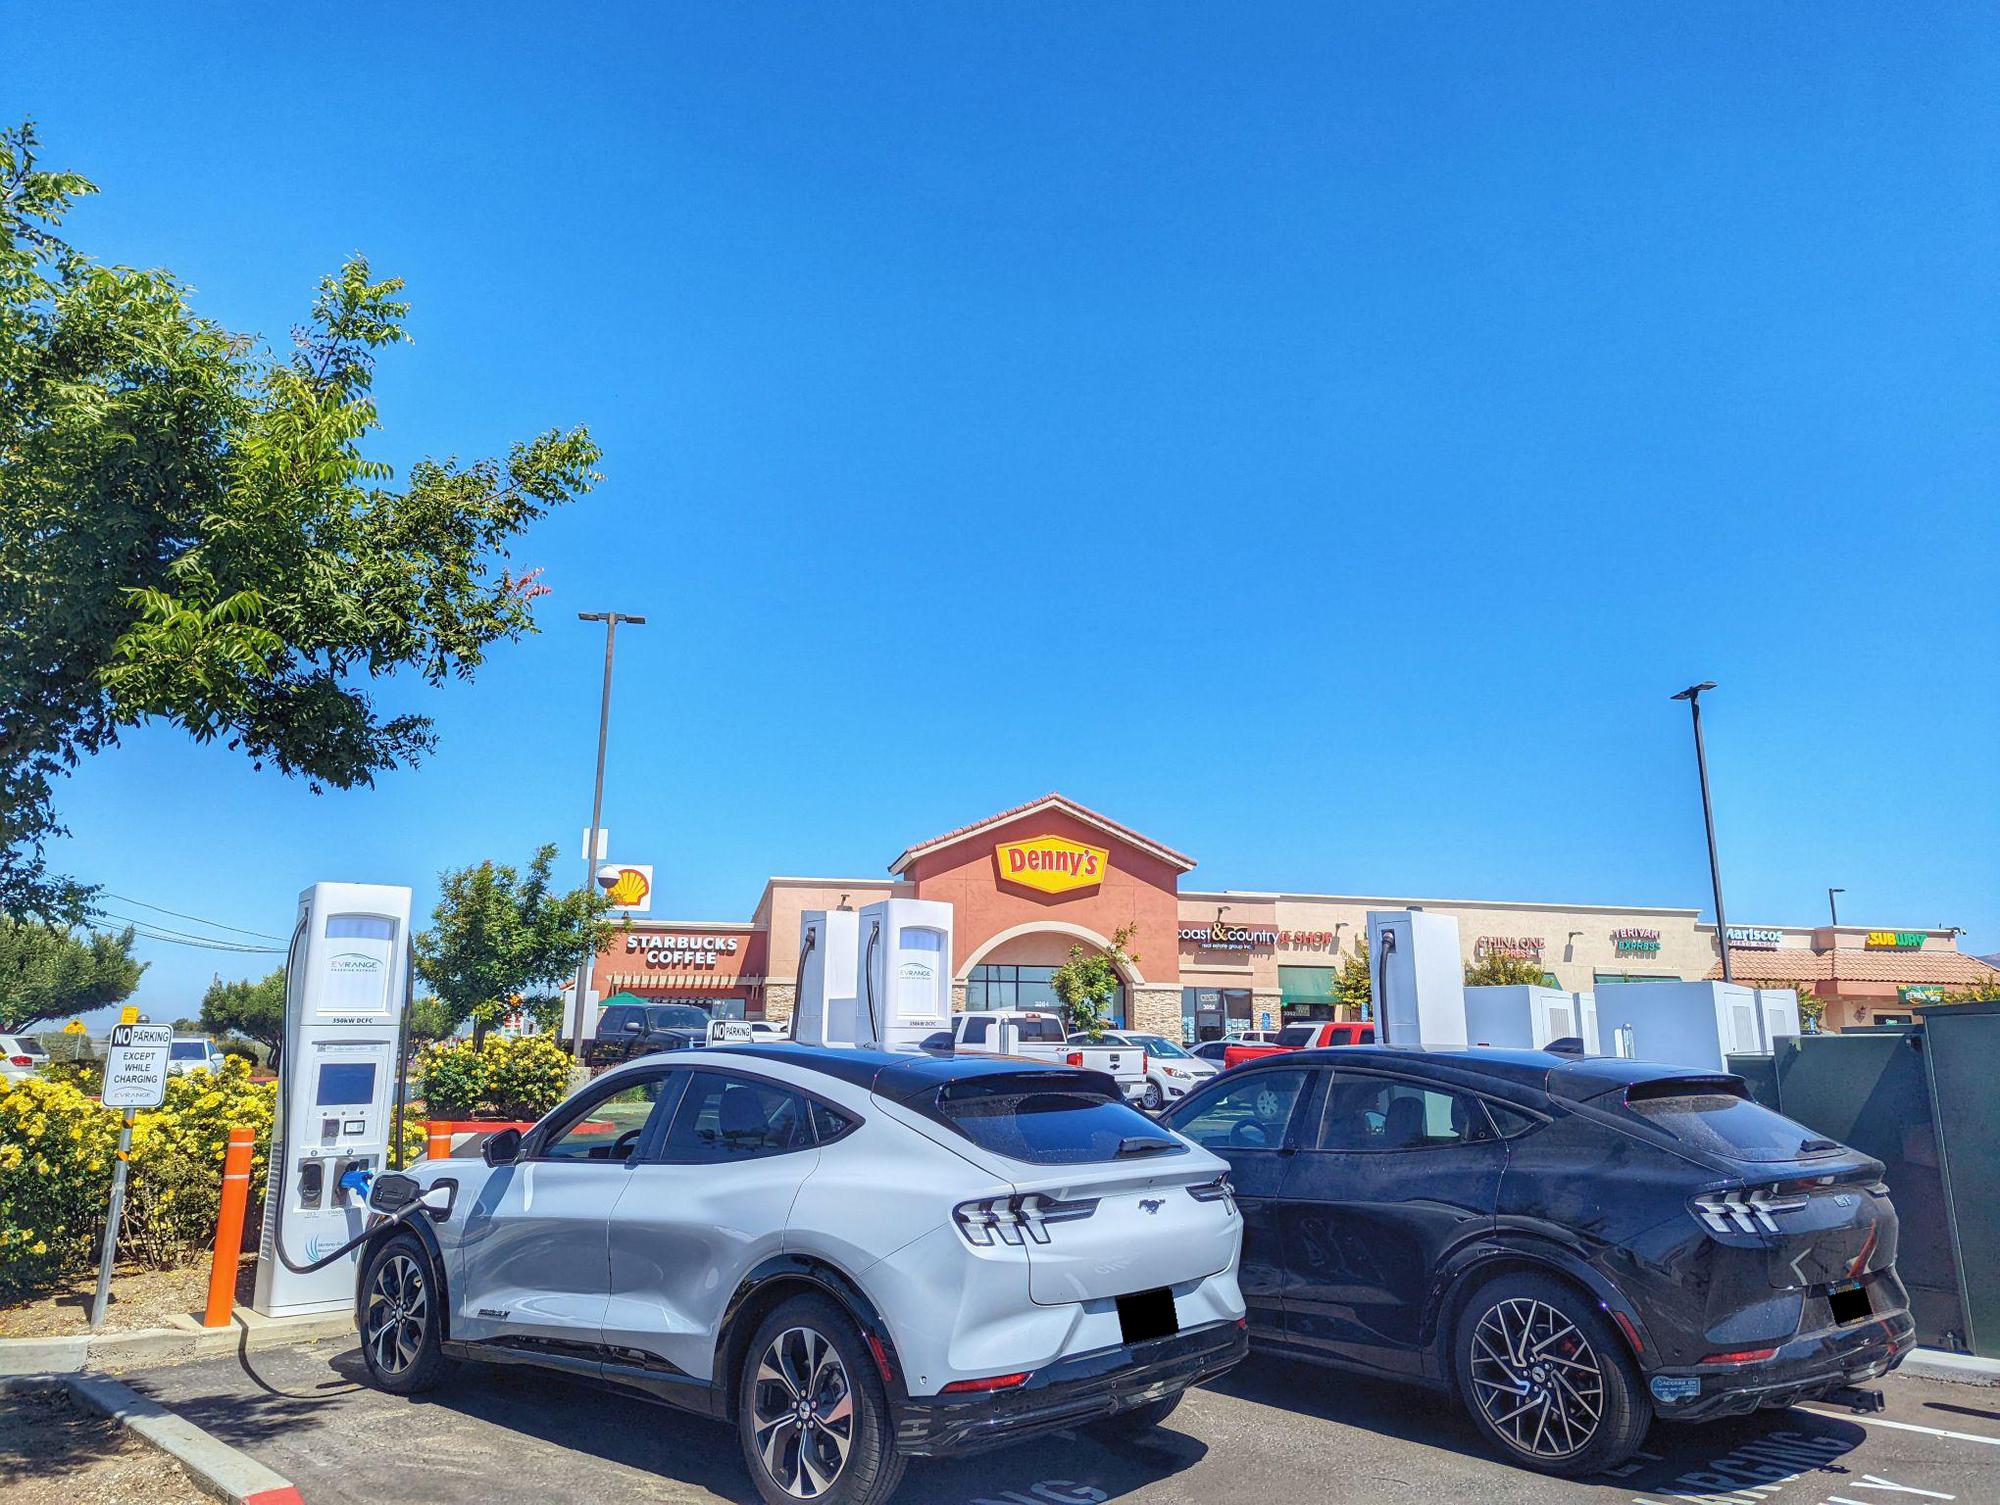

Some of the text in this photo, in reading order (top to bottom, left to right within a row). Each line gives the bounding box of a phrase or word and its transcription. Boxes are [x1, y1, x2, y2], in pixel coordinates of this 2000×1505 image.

[1008, 848, 1098, 876] Denny's
[1212, 922, 1228, 941] &
[1228, 929, 1279, 945] country
[1295, 931, 1332, 944] SHOP
[1868, 931, 1927, 946] SUBWAY
[627, 936, 738, 950] STARBUCKS
[1477, 936, 1545, 949] CHINA ONE
[647, 951, 717, 964] COFFEE
[114, 1028, 168, 1044] NO PARKING
[714, 1024, 750, 1038] NO PARKING
[123, 1052, 155, 1060] EXCEPT
[114, 1075, 157, 1083] CHARGING
